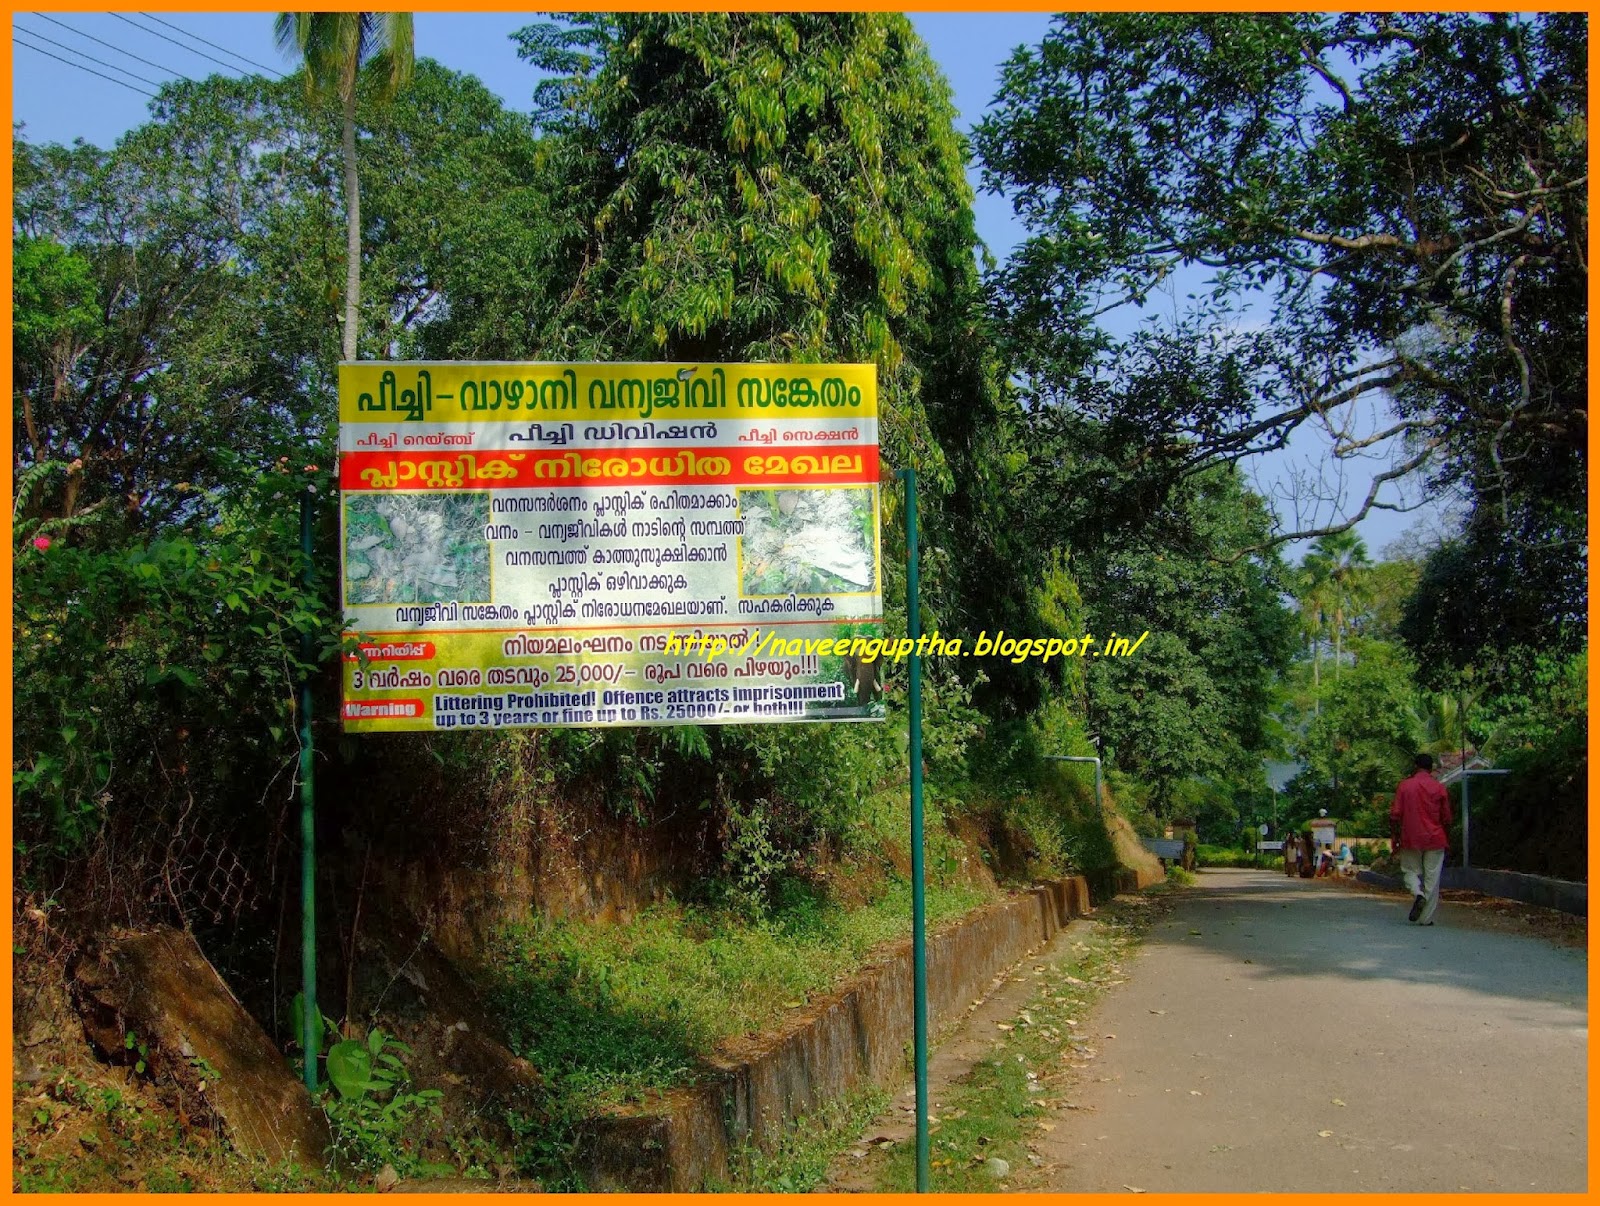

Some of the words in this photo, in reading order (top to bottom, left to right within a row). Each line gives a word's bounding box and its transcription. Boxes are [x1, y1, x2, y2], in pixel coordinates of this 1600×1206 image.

[589, 367, 726, 418] വന്യജീവി
[737, 377, 861, 408] സങ്കേതം
[357, 432, 397, 448] പീച്ചി
[509, 423, 574, 445] പീച്ചി
[584, 422, 718, 441] ഡിവിഷൻ
[738, 428, 777, 444] പീച്ചി
[783, 427, 859, 442] സെക്ഷൻ
[360, 453, 526, 488] പ്ലാസ്റ്റിക്
[534, 451, 731, 479] നിരോധിത
[744, 455, 863, 475] മേഖല
[593, 490, 646, 517] പ്ലാസ്റ്റിക്
[650, 489, 738, 510] രഹിതമാക്കാം
[486, 524, 518, 539] വനം
[539, 519, 627, 543] വന്യജീവികൾ
[690, 516, 747, 536] സമ്പത്ത്
[505, 546, 589, 566] വനസമ്പത്ത്
[549, 571, 603, 598] പ്ലാസ്റ്റിക്
[606, 571, 688, 594] ഒഴിവാക്കുക
[396, 602, 458, 626] വന്യജീവി
[462, 606, 518, 621] സങ്കേതം
[524, 599, 577, 625] പ്ലാസ്റ്റിക്
[738, 596, 835, 617] സഹകരിക്കുക
[504, 634, 633, 656] നിയമലംഘനം
[354, 671, 363, 688] 3
[370, 667, 431, 688] വർഷം
[438, 668, 481, 686] വരെ
[488, 666, 549, 688] തടവും
[645, 663, 680, 684] രൂപ
[687, 662, 727, 680] വരെ
[346, 702, 416, 717] Warning
[436, 694, 501, 711] Littering
[508, 691, 596, 709] Prohibited!
[604, 689, 663, 705] Offence
[667, 686, 729, 702] attracts
[733, 683, 842, 703] imprisonment
[436, 714, 455, 727] up
[461, 712, 475, 725] to
[480, 711, 489, 724] 3
[493, 712, 537, 727] years
[542, 711, 559, 723] or
[563, 709, 593, 723] fine
[597, 709, 616, 723] up
[621, 707, 635, 720] to
[640, 705, 663, 720] Rs.
[733, 704, 749, 713] or
